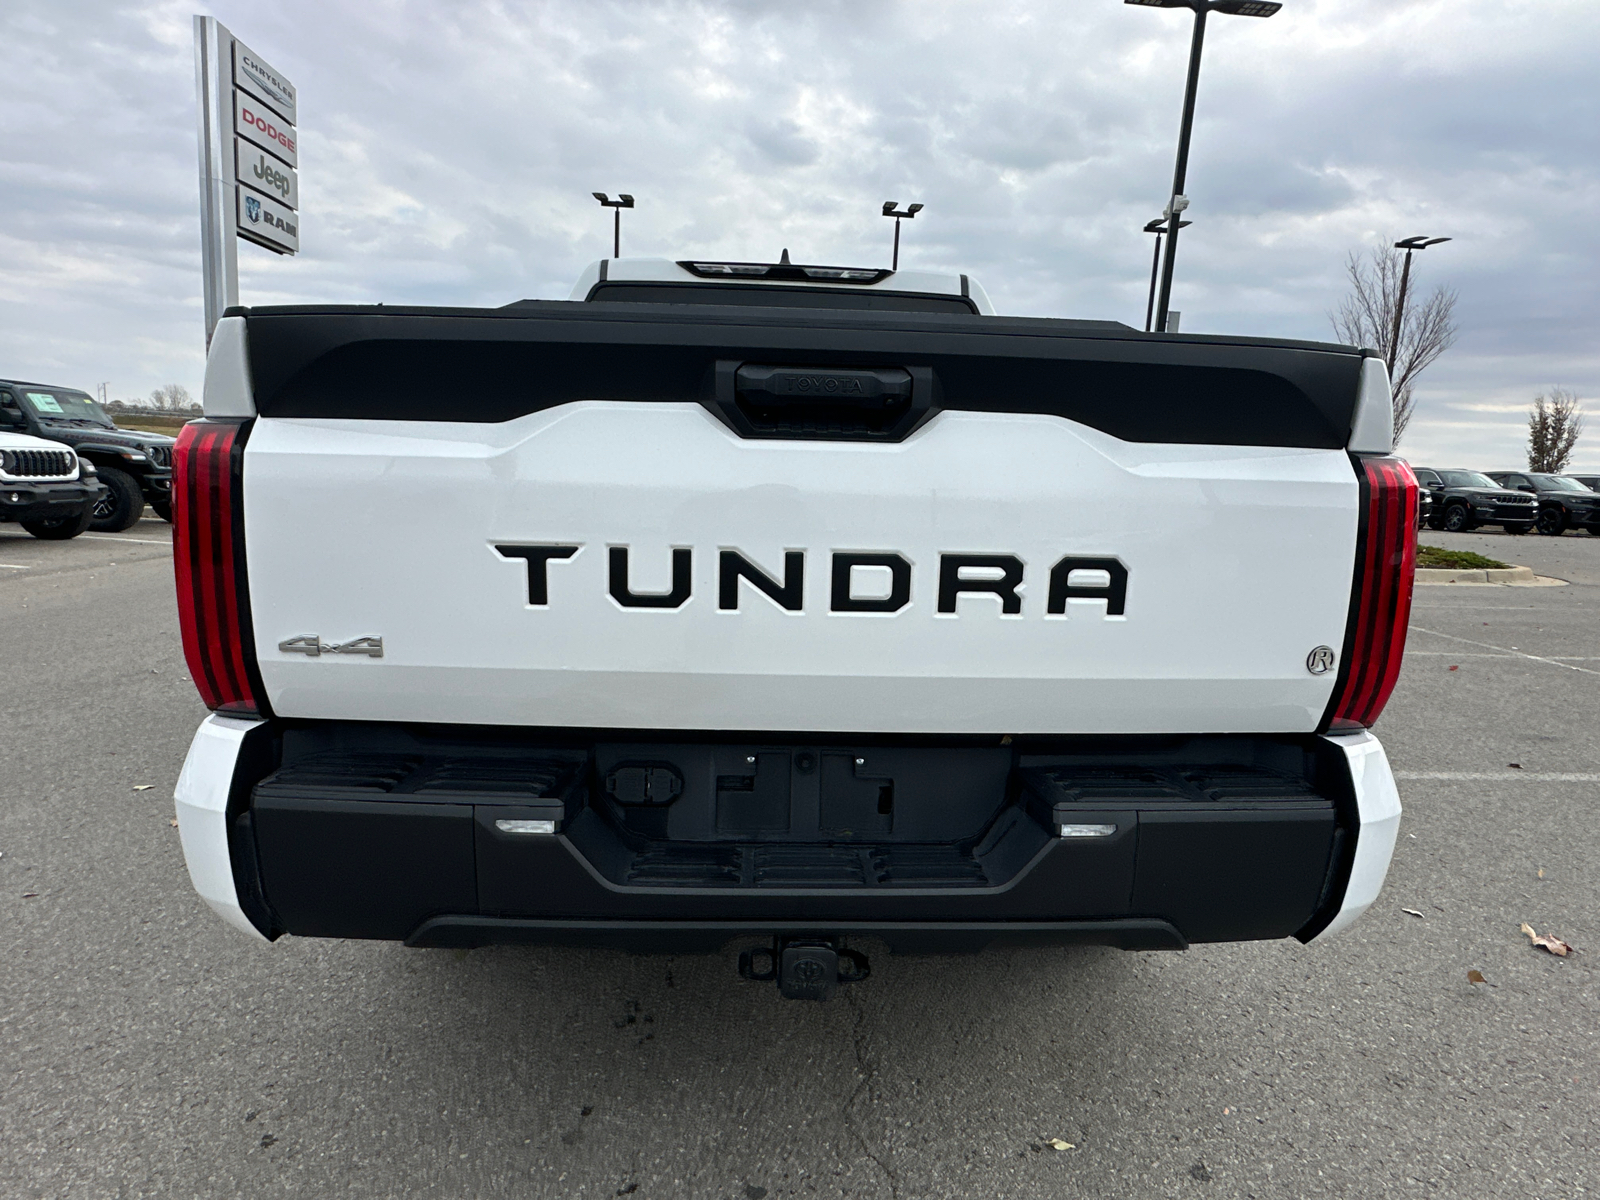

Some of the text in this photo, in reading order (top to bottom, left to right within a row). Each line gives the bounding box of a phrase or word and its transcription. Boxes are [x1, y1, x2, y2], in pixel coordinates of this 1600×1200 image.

[243, 56, 294, 100] CHRYSLER
[242, 108, 296, 153] DODGE
[253, 154, 290, 198] Jeep
[263, 210, 296, 238] RAM
[785, 376, 863, 394] TOYOTA
[492, 543, 1130, 617] TUNDRA
